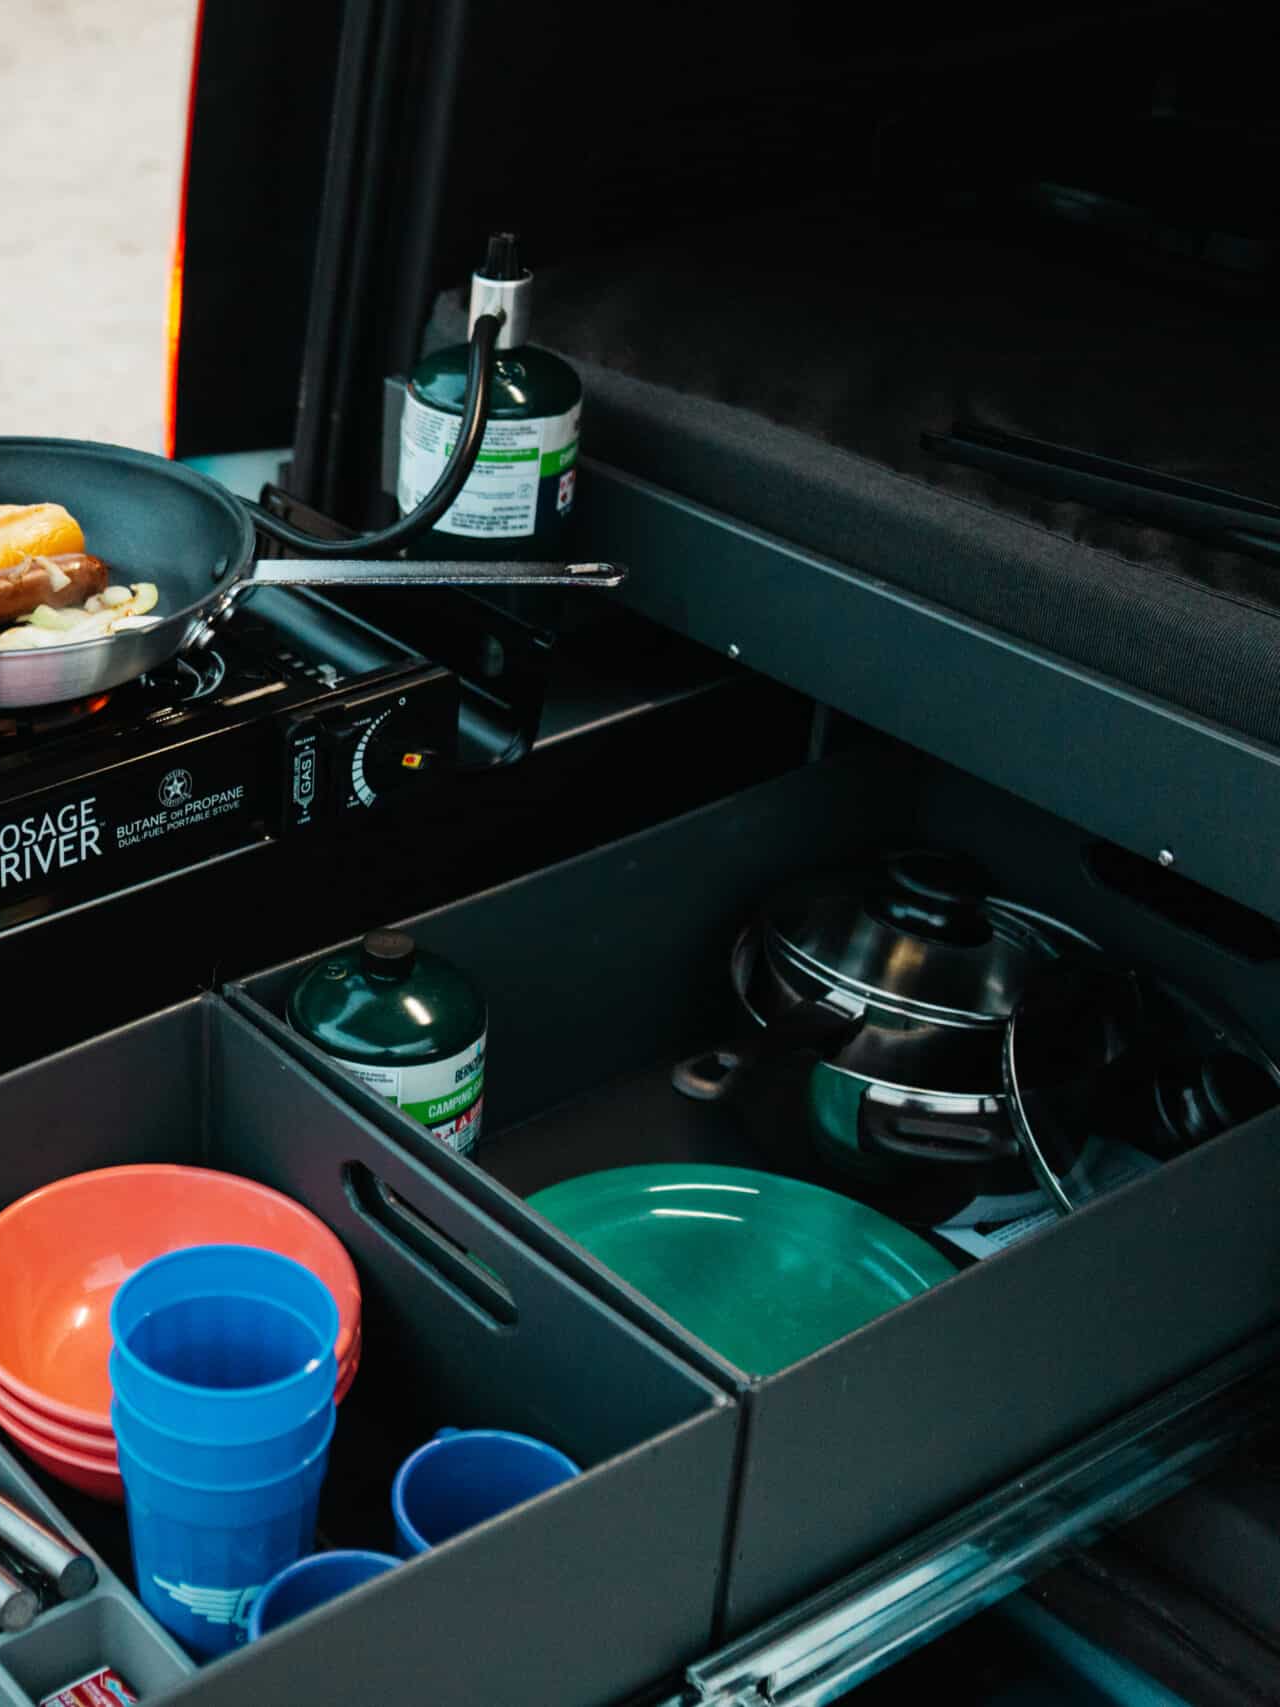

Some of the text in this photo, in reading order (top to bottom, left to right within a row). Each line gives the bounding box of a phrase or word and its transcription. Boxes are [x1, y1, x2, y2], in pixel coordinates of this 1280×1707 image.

[300, 758, 313, 794] GAS
[116, 810, 168, 839] BUTANE
[170, 808, 184, 820] OR
[183, 785, 245, 816] PROPANE
[166, 810, 210, 832] PORTABLE
[212, 799, 241, 817] STOVE
[0, 825, 103, 888] RIVER
